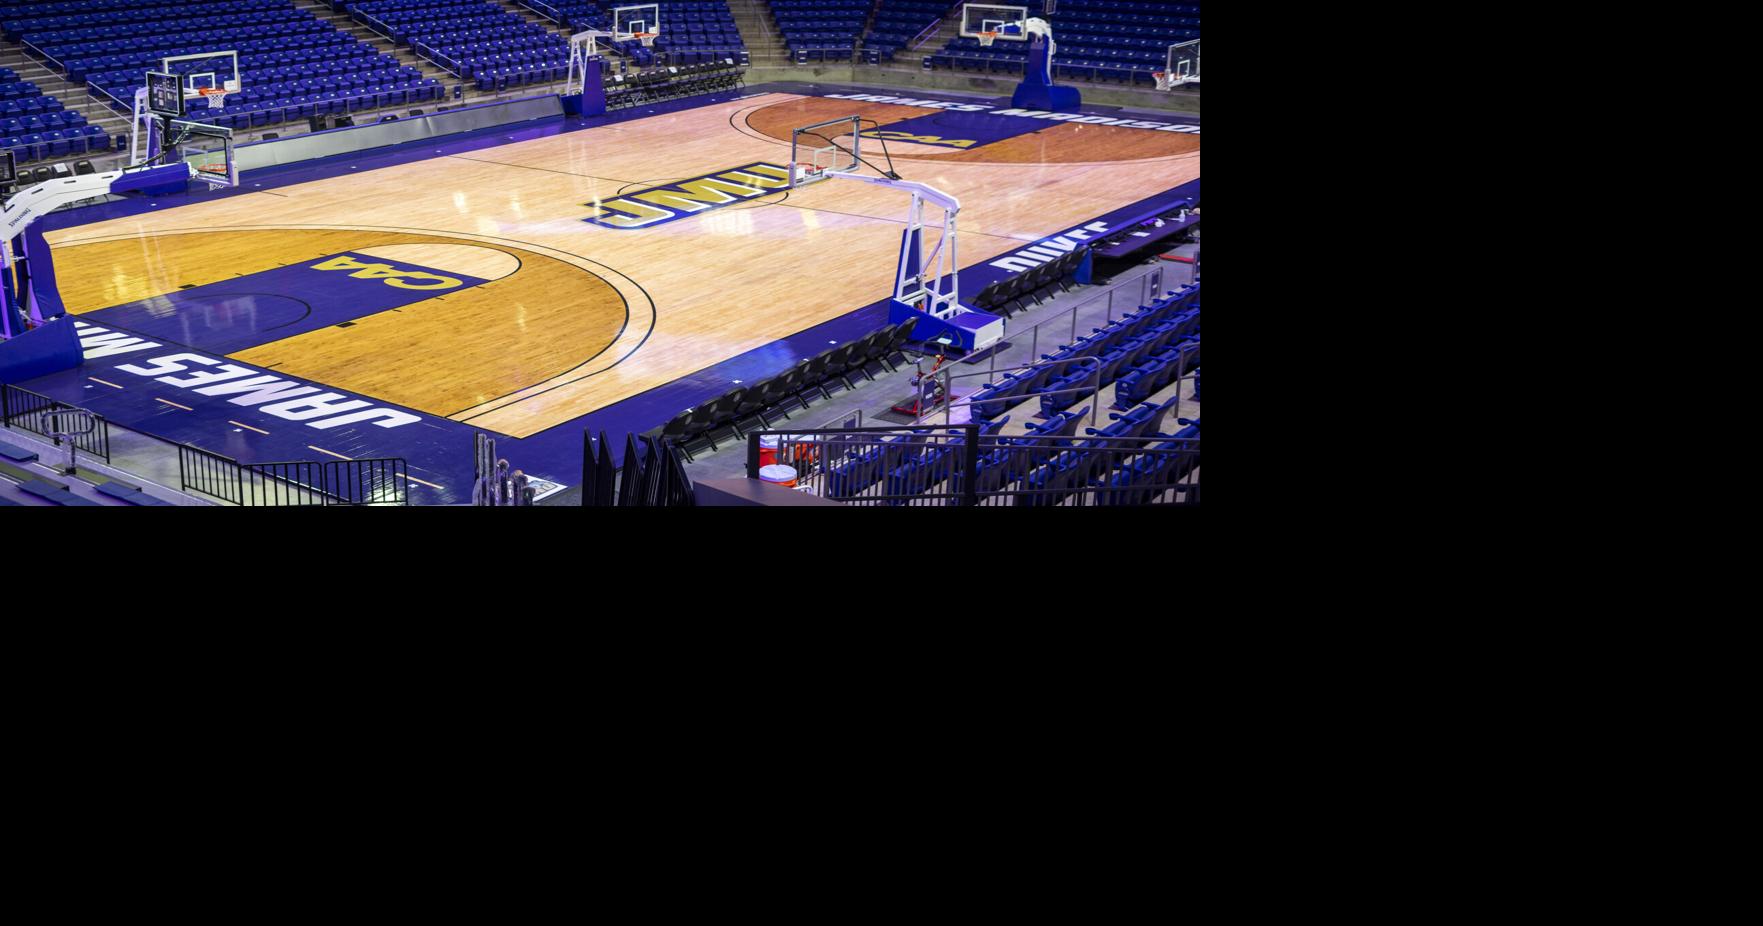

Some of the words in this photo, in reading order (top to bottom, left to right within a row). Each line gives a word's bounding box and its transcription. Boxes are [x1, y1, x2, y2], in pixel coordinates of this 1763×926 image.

[824, 94, 995, 112] JAMES
[989, 108, 1200, 134] MADISO
[860, 131, 977, 147] CAA
[581, 162, 792, 229] JMU
[310, 255, 463, 290] CAA
[114, 353, 422, 430] JAMES
